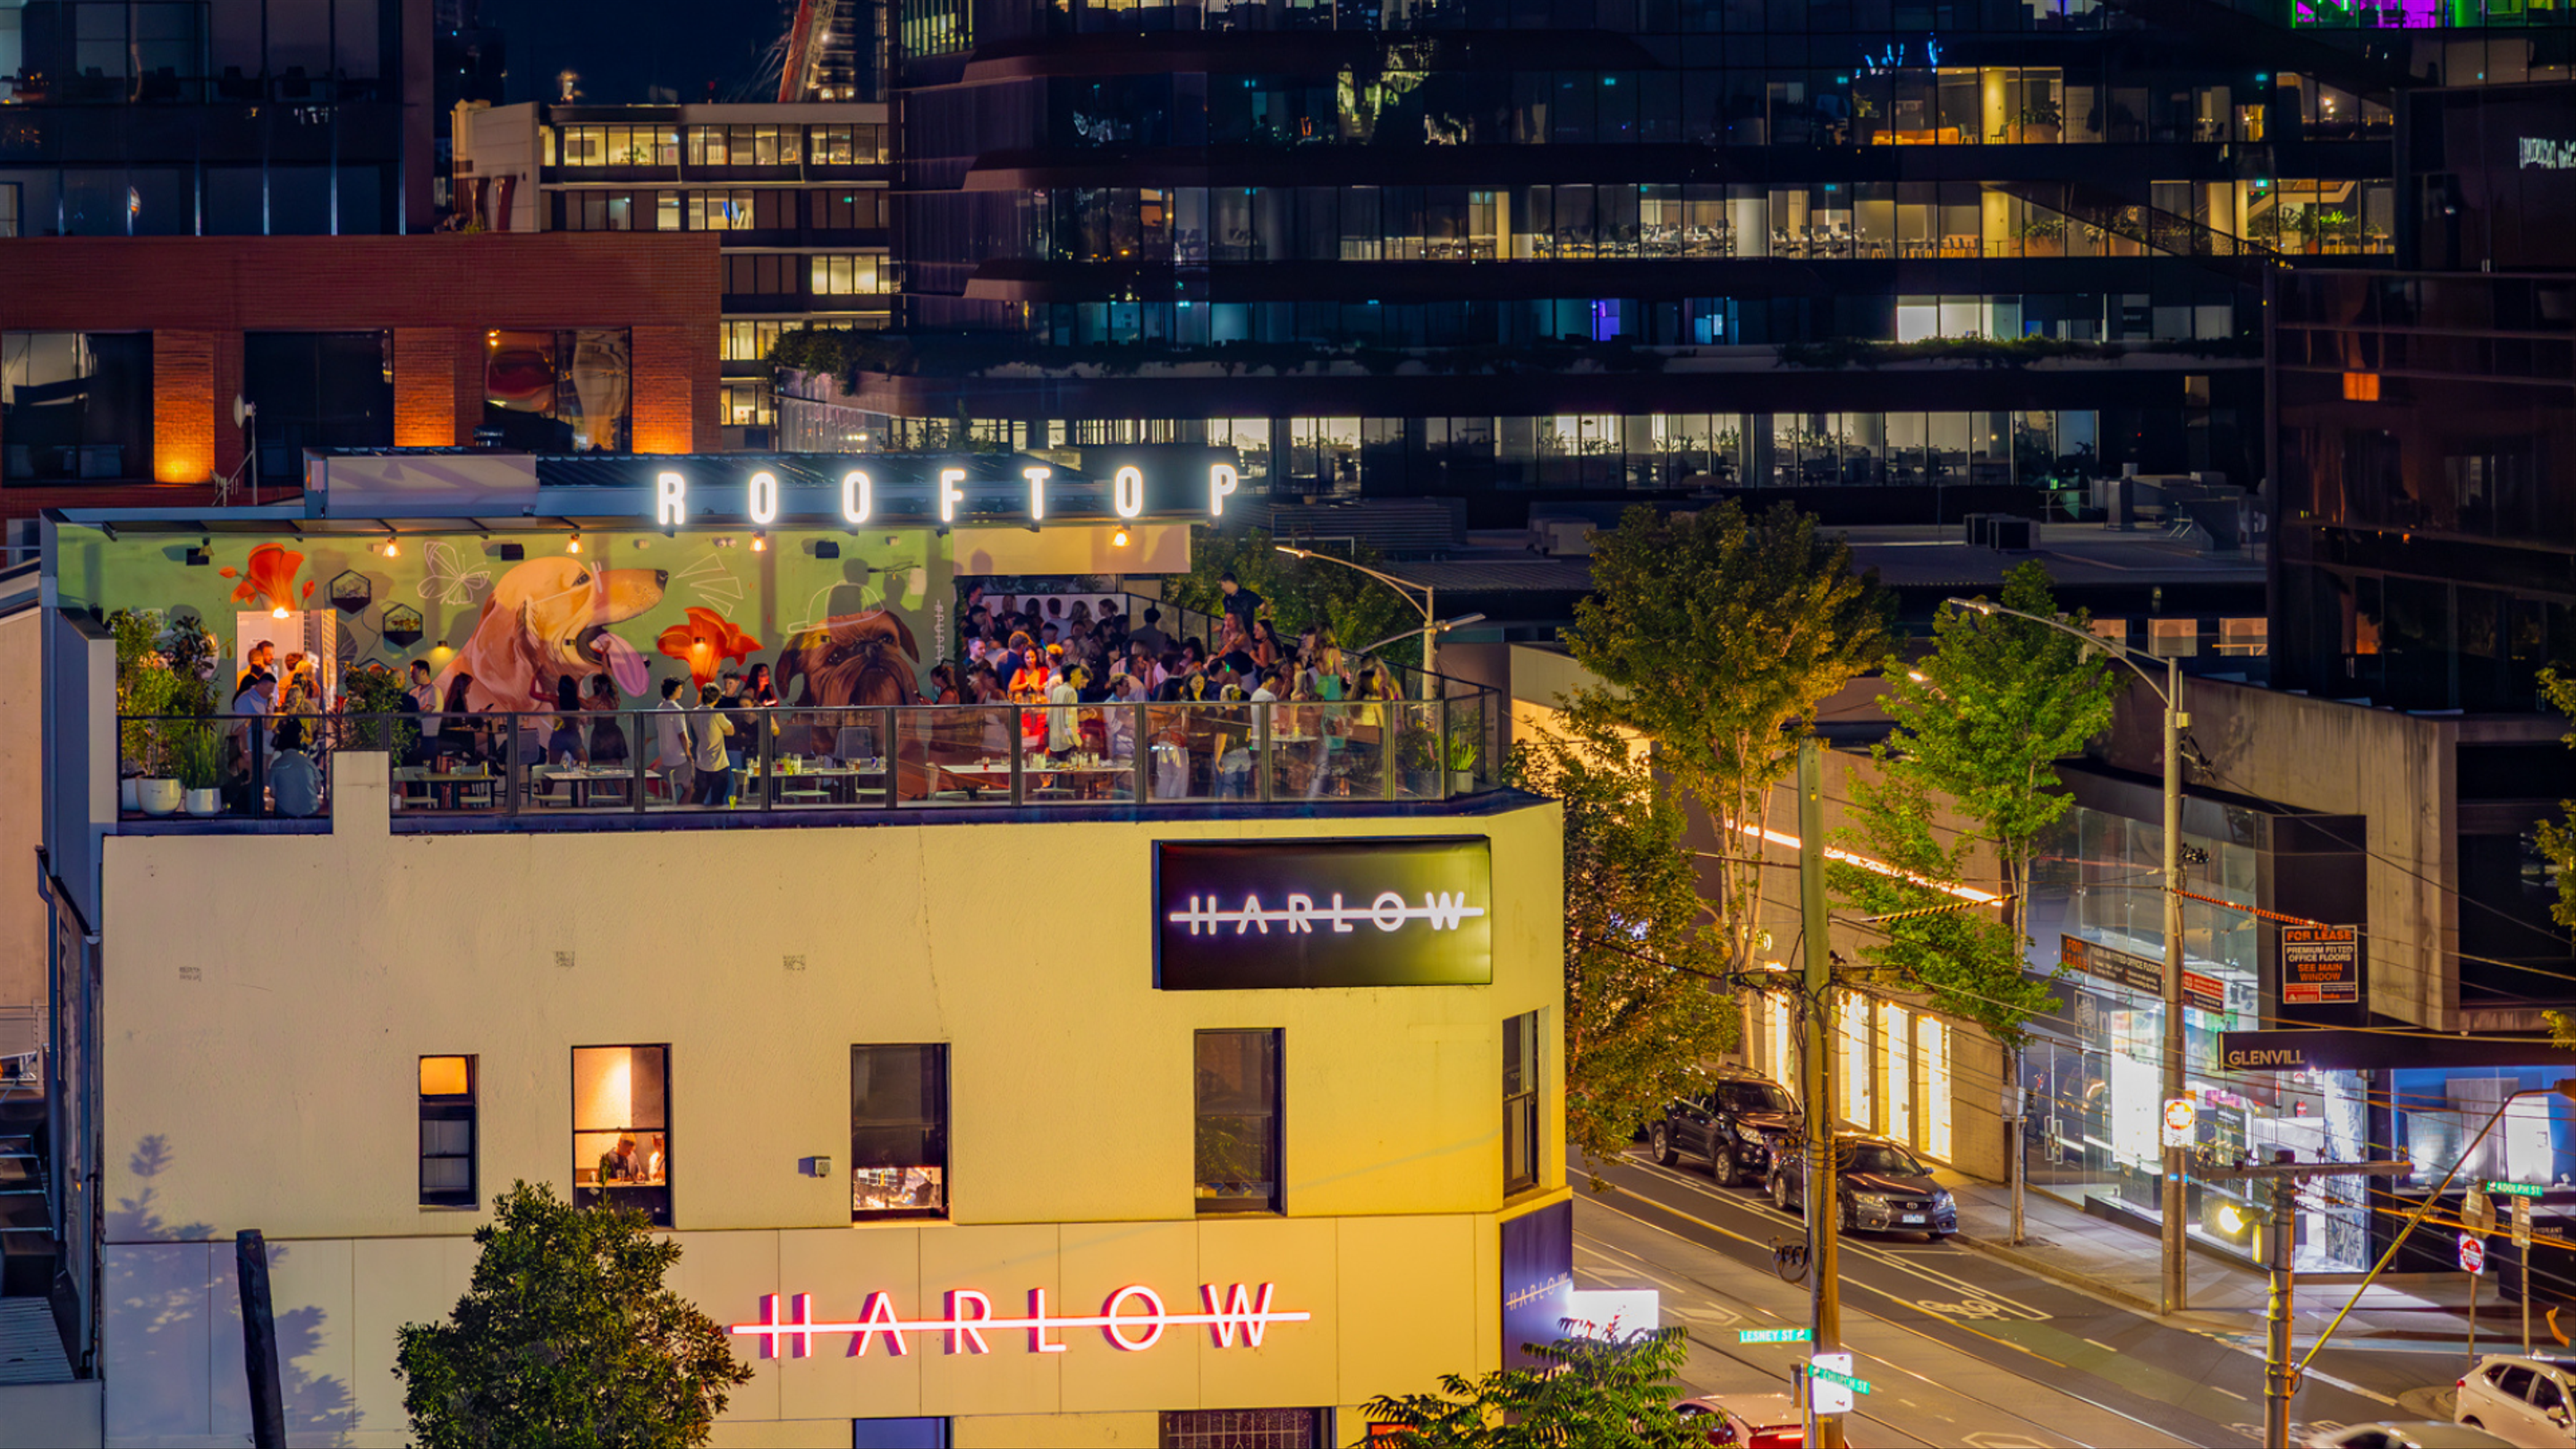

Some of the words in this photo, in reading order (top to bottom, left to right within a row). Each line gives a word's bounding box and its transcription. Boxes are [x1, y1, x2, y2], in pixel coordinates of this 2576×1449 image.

[657, 462, 1239, 525] ROOFTOP
[1188, 891, 1467, 936] HARLOW
[2286, 930, 2311, 941] FOR
[2314, 929, 2352, 941] LEASE
[2065, 938, 2083, 954] FOR
[2286, 945, 2324, 953] PREMIUM
[2325, 945, 2353, 953] FITTED
[2062, 951, 2089, 971] LEASE
[2288, 953, 2317, 962] OFFICE
[2318, 953, 2351, 962] FLOORS
[2298, 963, 2317, 972] SEE
[2318, 963, 2343, 971] MAIN
[2299, 972, 2341, 981] WINDOW
[2228, 1049, 2305, 1066] GLENVILL
[2496, 1182, 2529, 1194] ADOLPH
[2531, 1185, 2540, 1195] ST
[1508, 1272, 1568, 1311] HARLOW
[761, 1282, 1275, 1359] HARLOW
[1741, 1330, 1779, 1342] LESNEY
[1781, 1330, 1793, 1341] ST
[1822, 1369, 1855, 1390] CHURCH
[1857, 1380, 1868, 1393] ST
